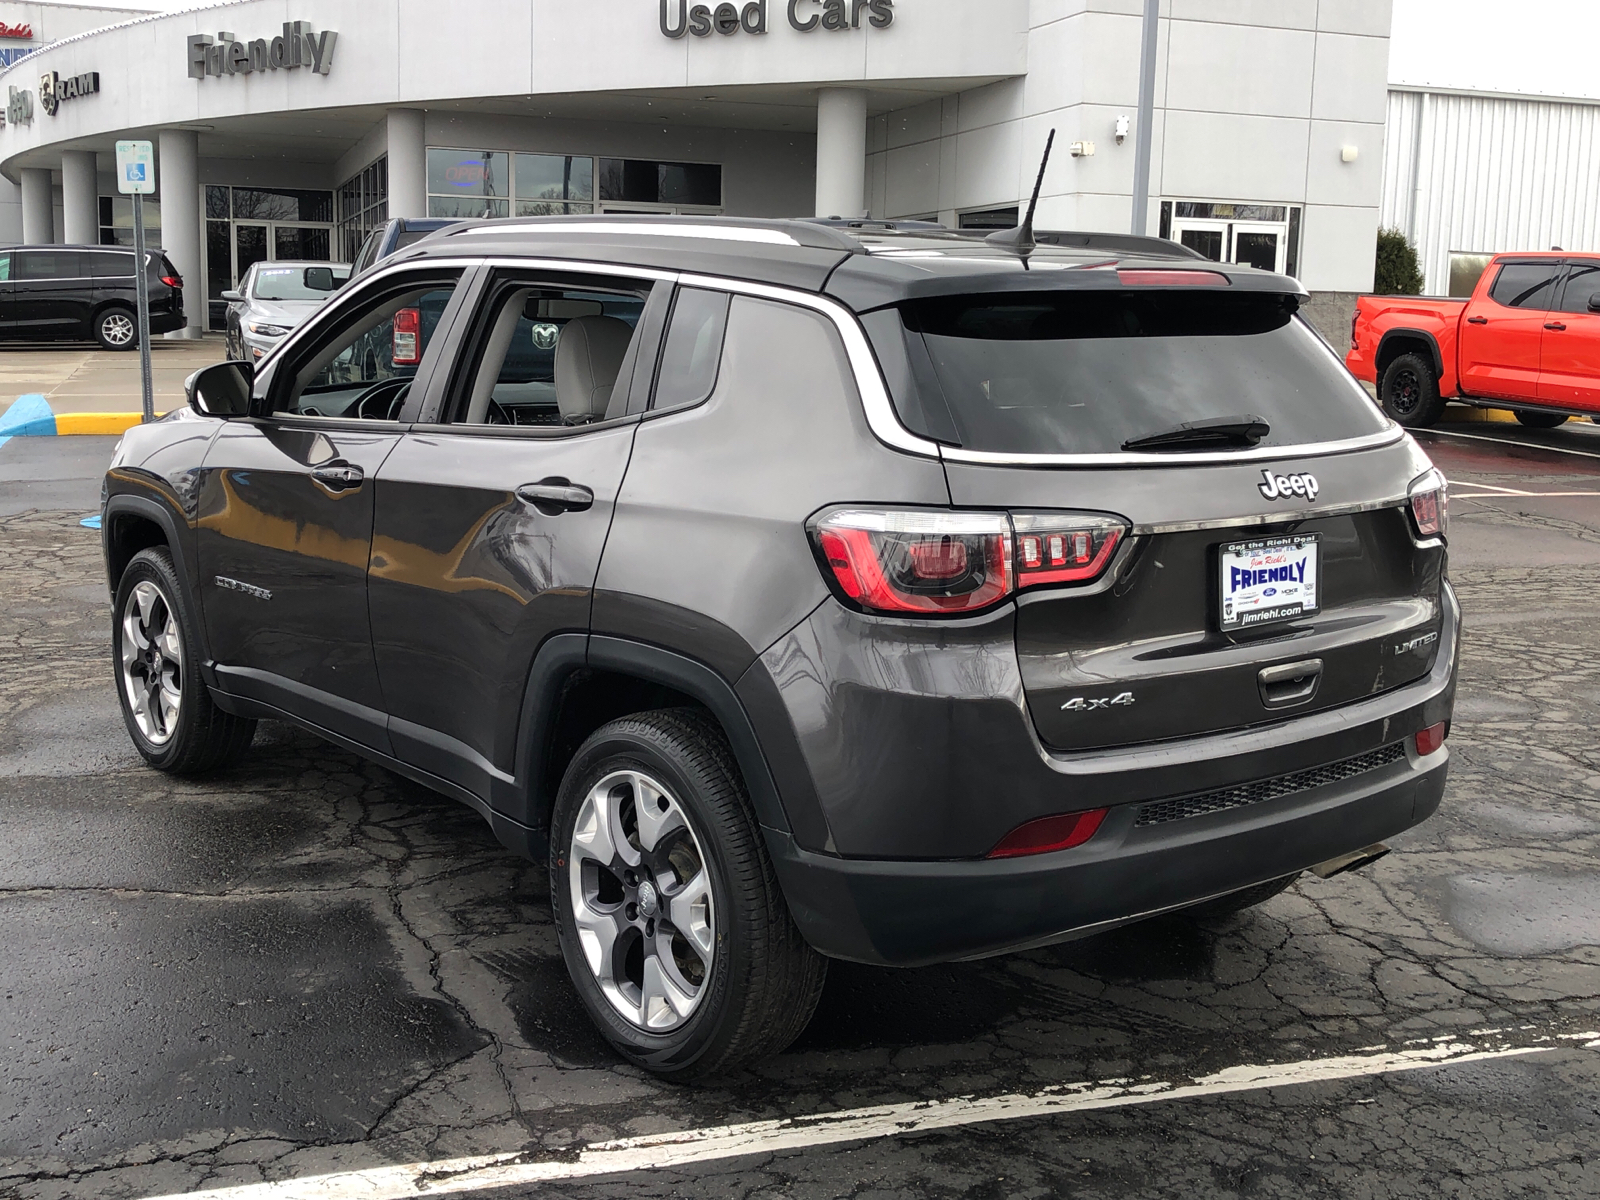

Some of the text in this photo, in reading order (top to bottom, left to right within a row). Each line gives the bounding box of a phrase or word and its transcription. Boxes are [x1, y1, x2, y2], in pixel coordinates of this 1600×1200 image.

[659, 0, 894, 38] Used Cars
[187, 20, 338, 79] Friendly
[55, 71, 99, 100] RAM
[445, 166, 489, 181] OPEN
[1257, 469, 1319, 502] Jeep
[1248, 541, 1264, 549] the
[1266, 537, 1291, 546] Riehl
[1294, 535, 1315, 543] Deal
[1250, 554, 1287, 569] Jim Riehl's
[1230, 556, 1307, 594] FRIENDLY
[1242, 606, 1302, 625] jimriehl.com
[1394, 631, 1438, 656] LIMITED
[1060, 692, 1135, 712] 4x4
